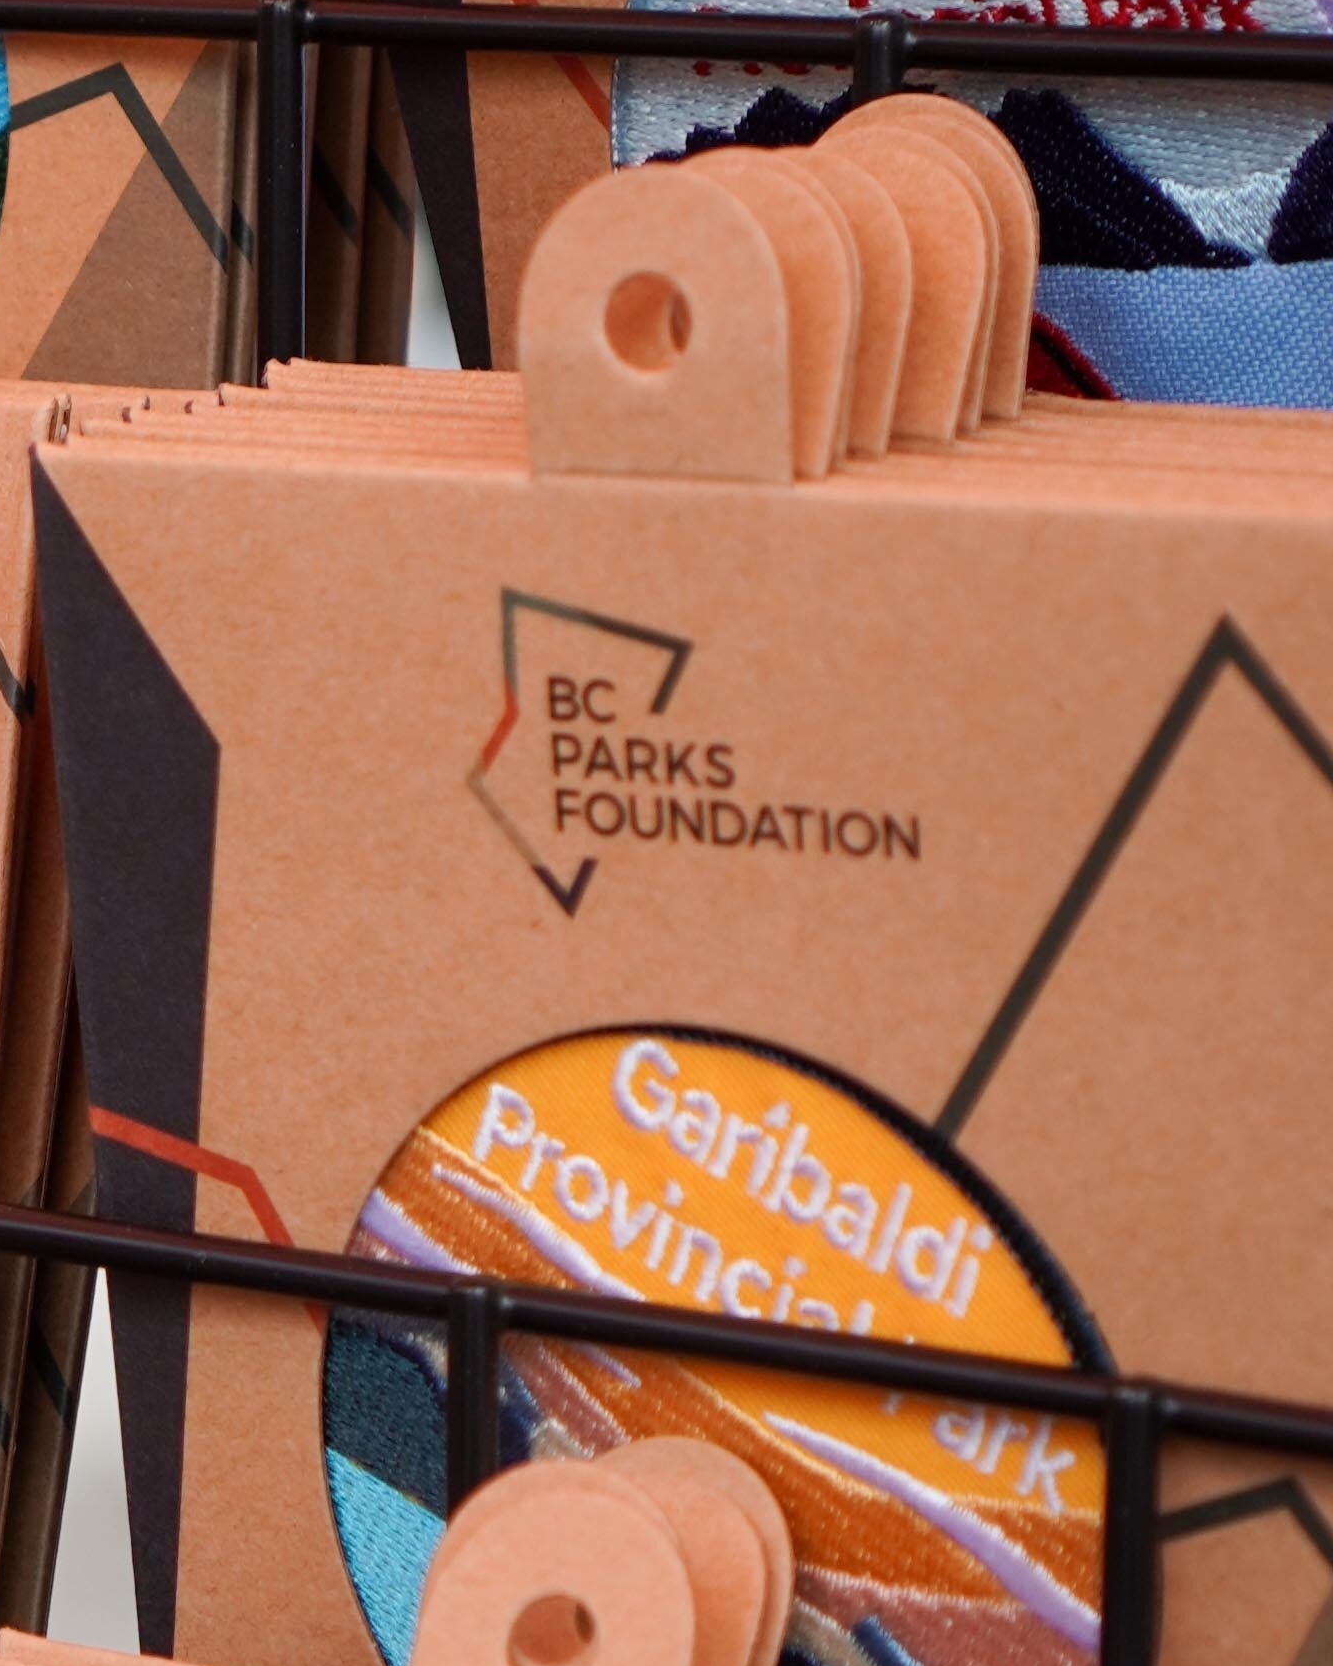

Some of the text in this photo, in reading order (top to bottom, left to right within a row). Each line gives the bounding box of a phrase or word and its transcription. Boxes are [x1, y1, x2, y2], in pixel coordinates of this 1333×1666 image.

[547, 676, 617, 724] BC
[550, 732, 735, 790] PARKS
[554, 788, 921, 862] FOUNDATION
[612, 1039, 993, 1320] Garibaldi
